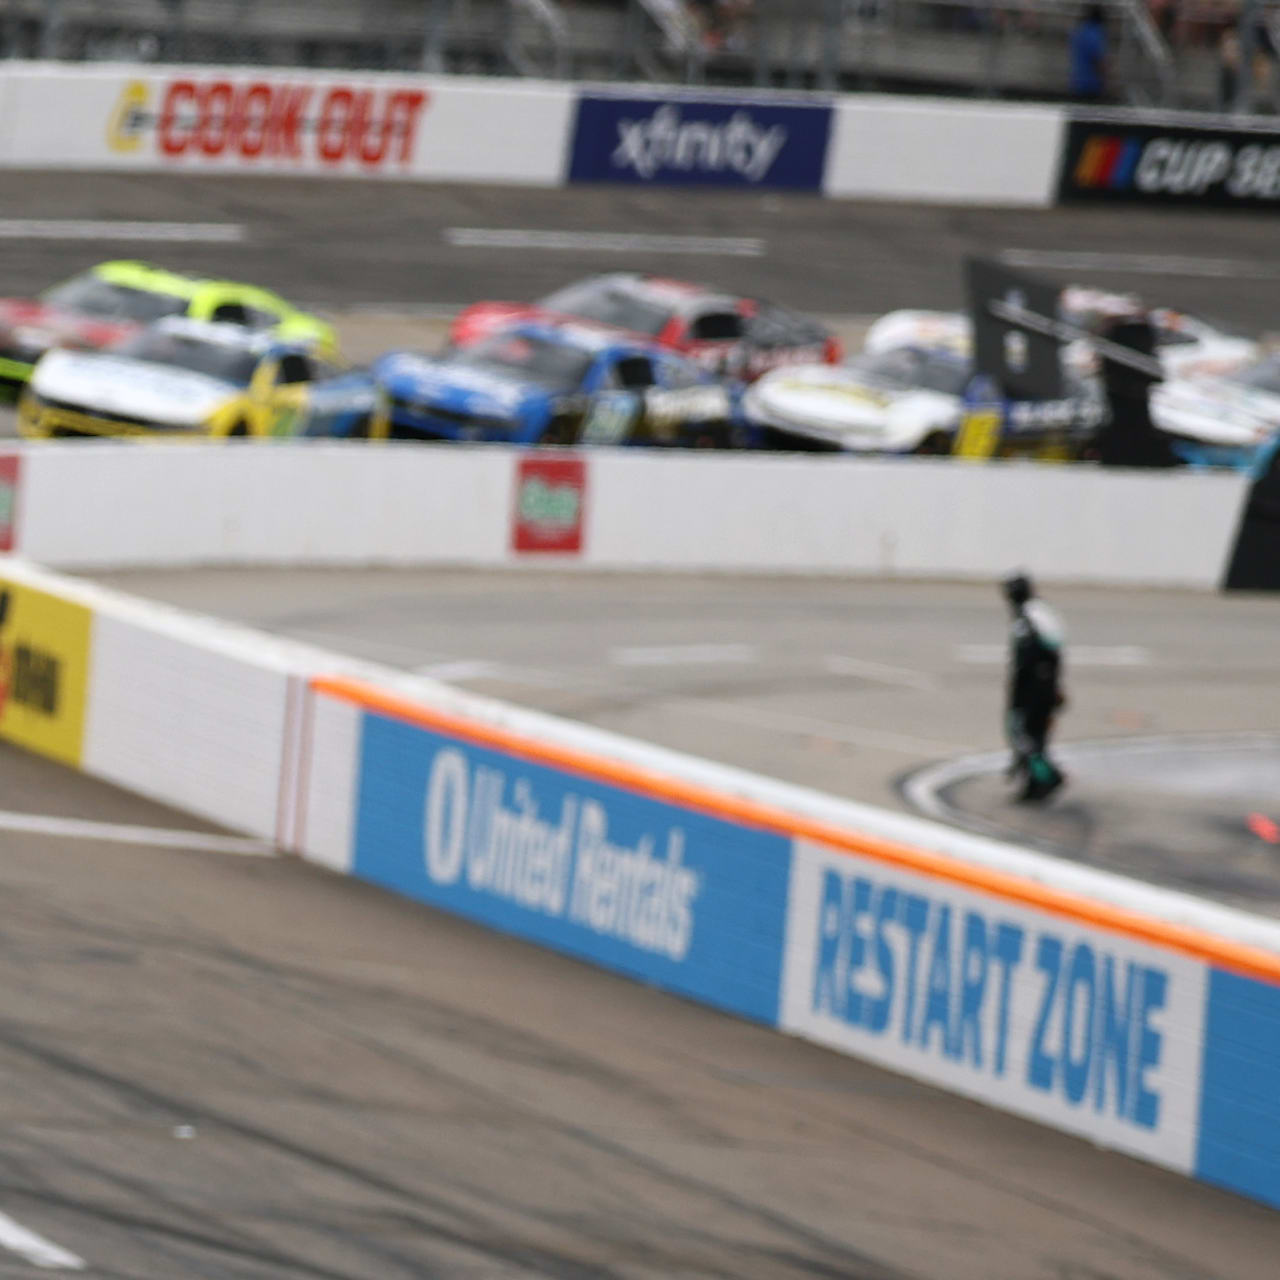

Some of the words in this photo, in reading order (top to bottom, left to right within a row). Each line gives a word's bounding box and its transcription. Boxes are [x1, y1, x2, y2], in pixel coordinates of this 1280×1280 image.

[155, 80, 313, 159] COOK
[316, 85, 430, 167] OUT
[1136, 135, 1232, 194] CUP
[466, 763, 580, 918] United
[570, 796, 702, 963] Rentals
[812, 866, 1026, 1082] RESTART
[1025, 928, 1171, 1133] ZONE
